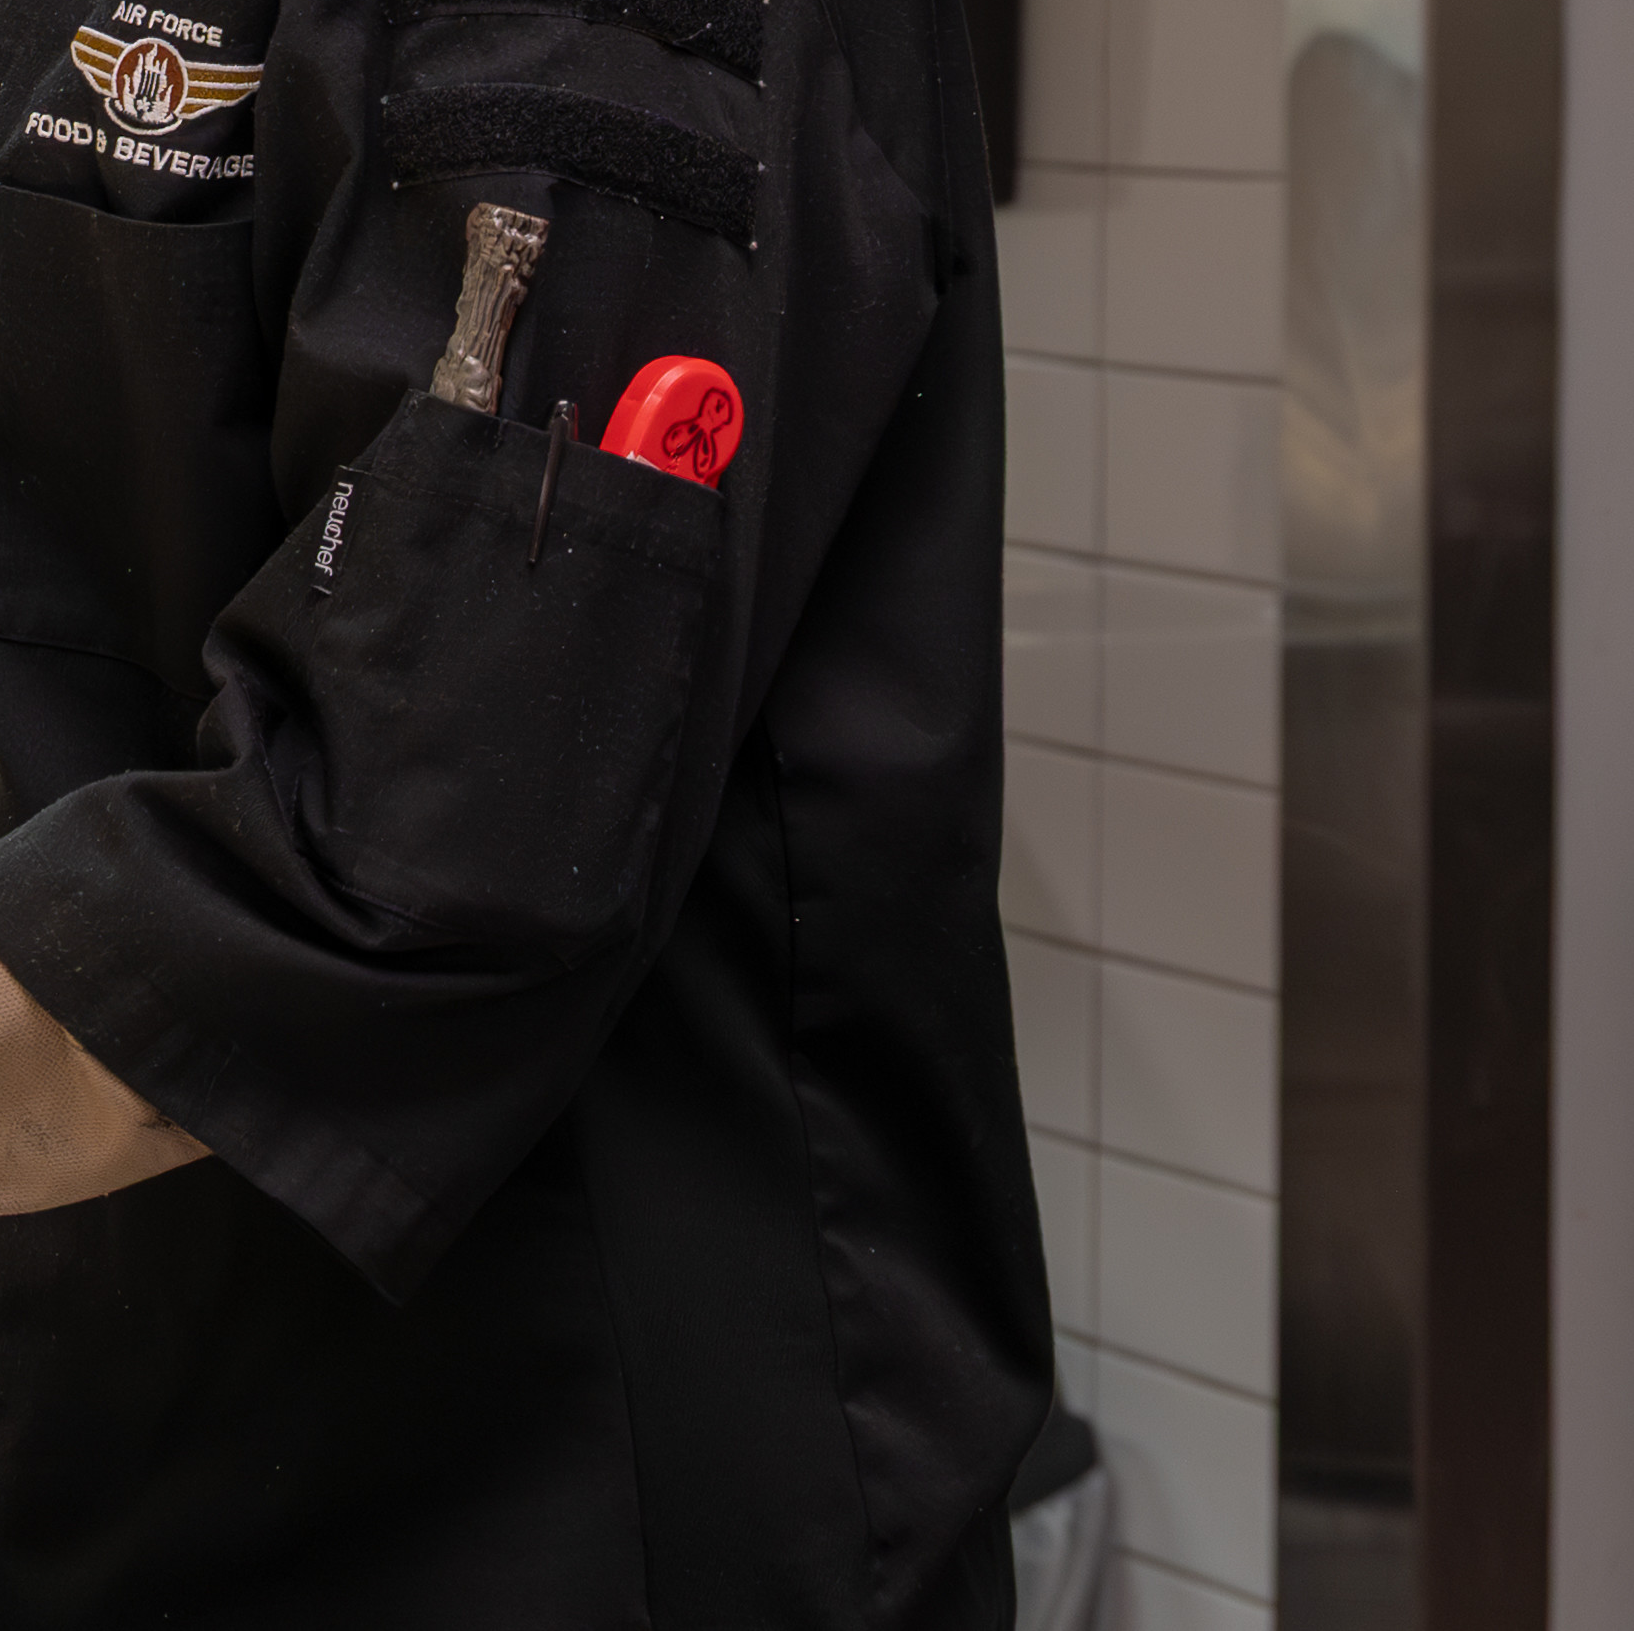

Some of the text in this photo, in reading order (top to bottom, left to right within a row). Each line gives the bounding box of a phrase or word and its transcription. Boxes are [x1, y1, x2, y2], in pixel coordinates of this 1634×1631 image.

[111, 0, 224, 48] AIR FORCE
[25, 111, 254, 180] FOOD & BEVERAGE
